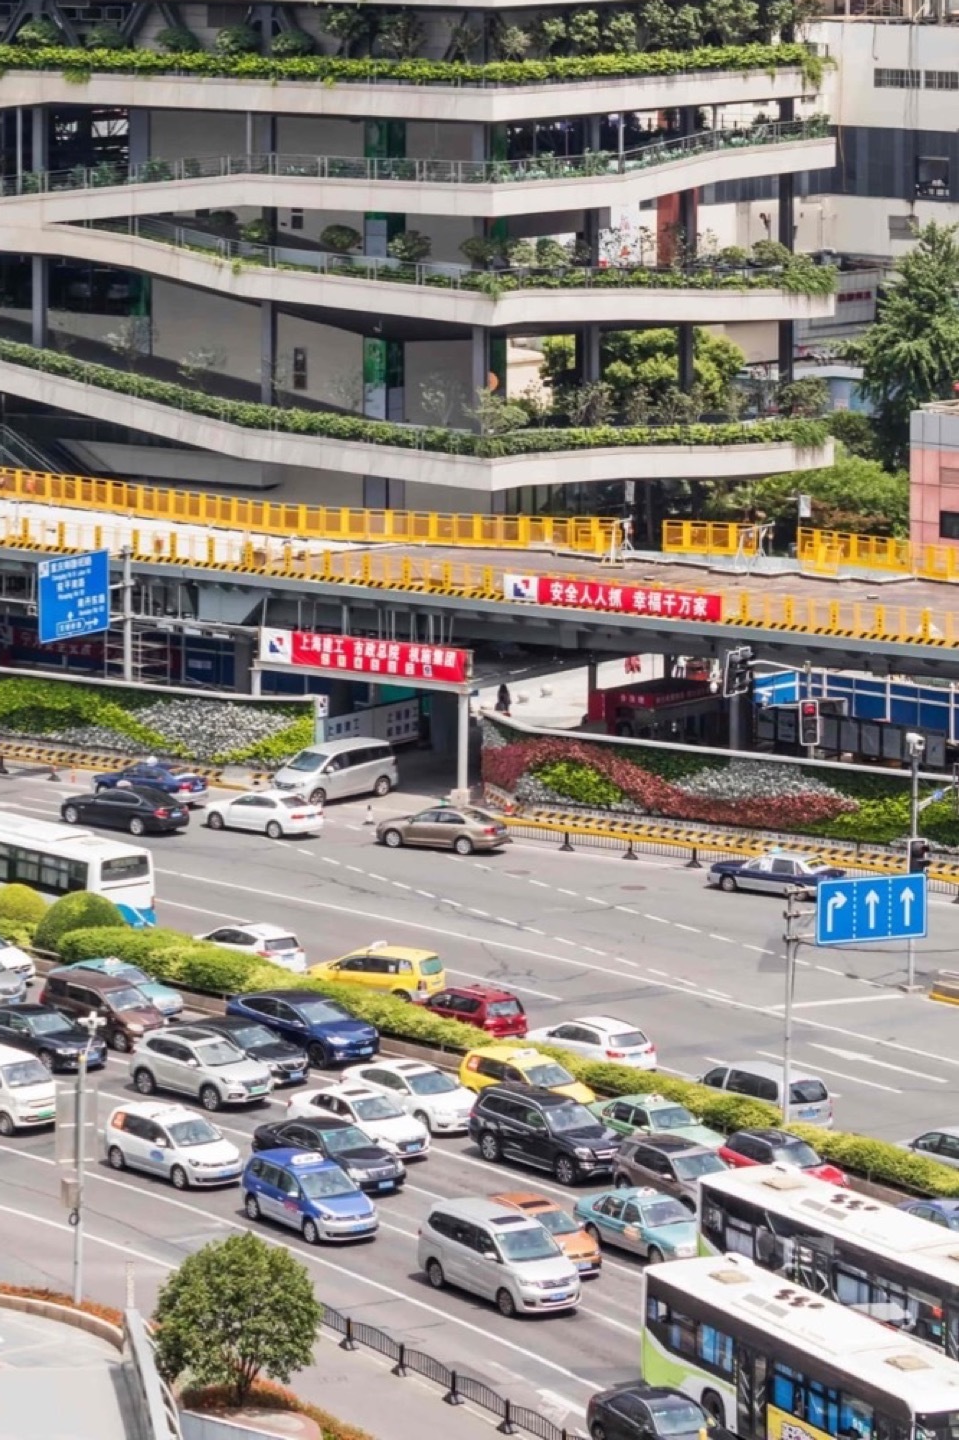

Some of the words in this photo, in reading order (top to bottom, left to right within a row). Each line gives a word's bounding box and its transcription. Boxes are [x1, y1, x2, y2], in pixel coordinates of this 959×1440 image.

[549, 581, 623, 608] 安全人人抓
[632, 593, 708, 617] 幸福千万家
